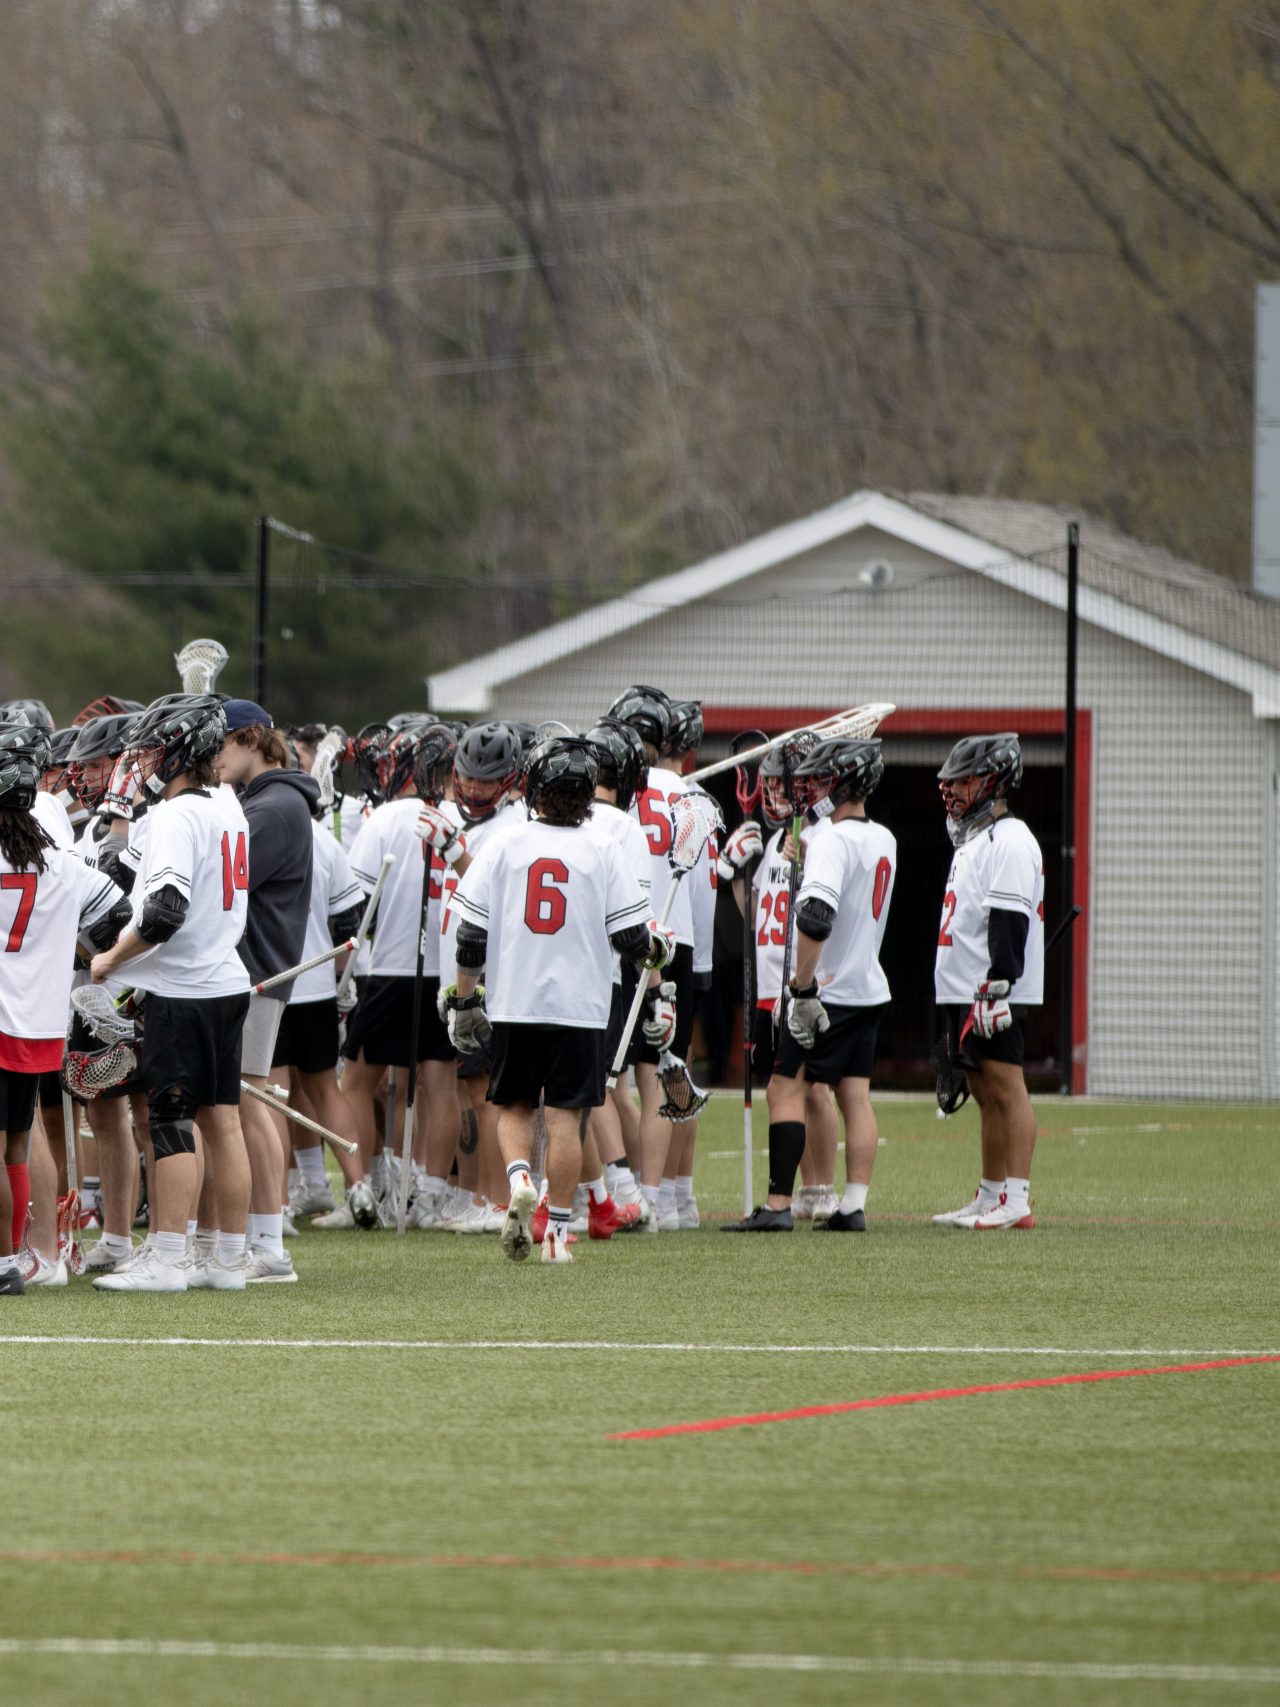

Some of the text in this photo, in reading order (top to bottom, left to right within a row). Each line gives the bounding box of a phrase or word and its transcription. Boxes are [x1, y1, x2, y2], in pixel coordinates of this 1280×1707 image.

[635, 787, 682, 856] 5
[221, 831, 249, 911] 14
[524, 857, 569, 935] 6
[872, 856, 892, 922] 0
[0, 873, 37, 952] 7
[757, 890, 789, 946] 29
